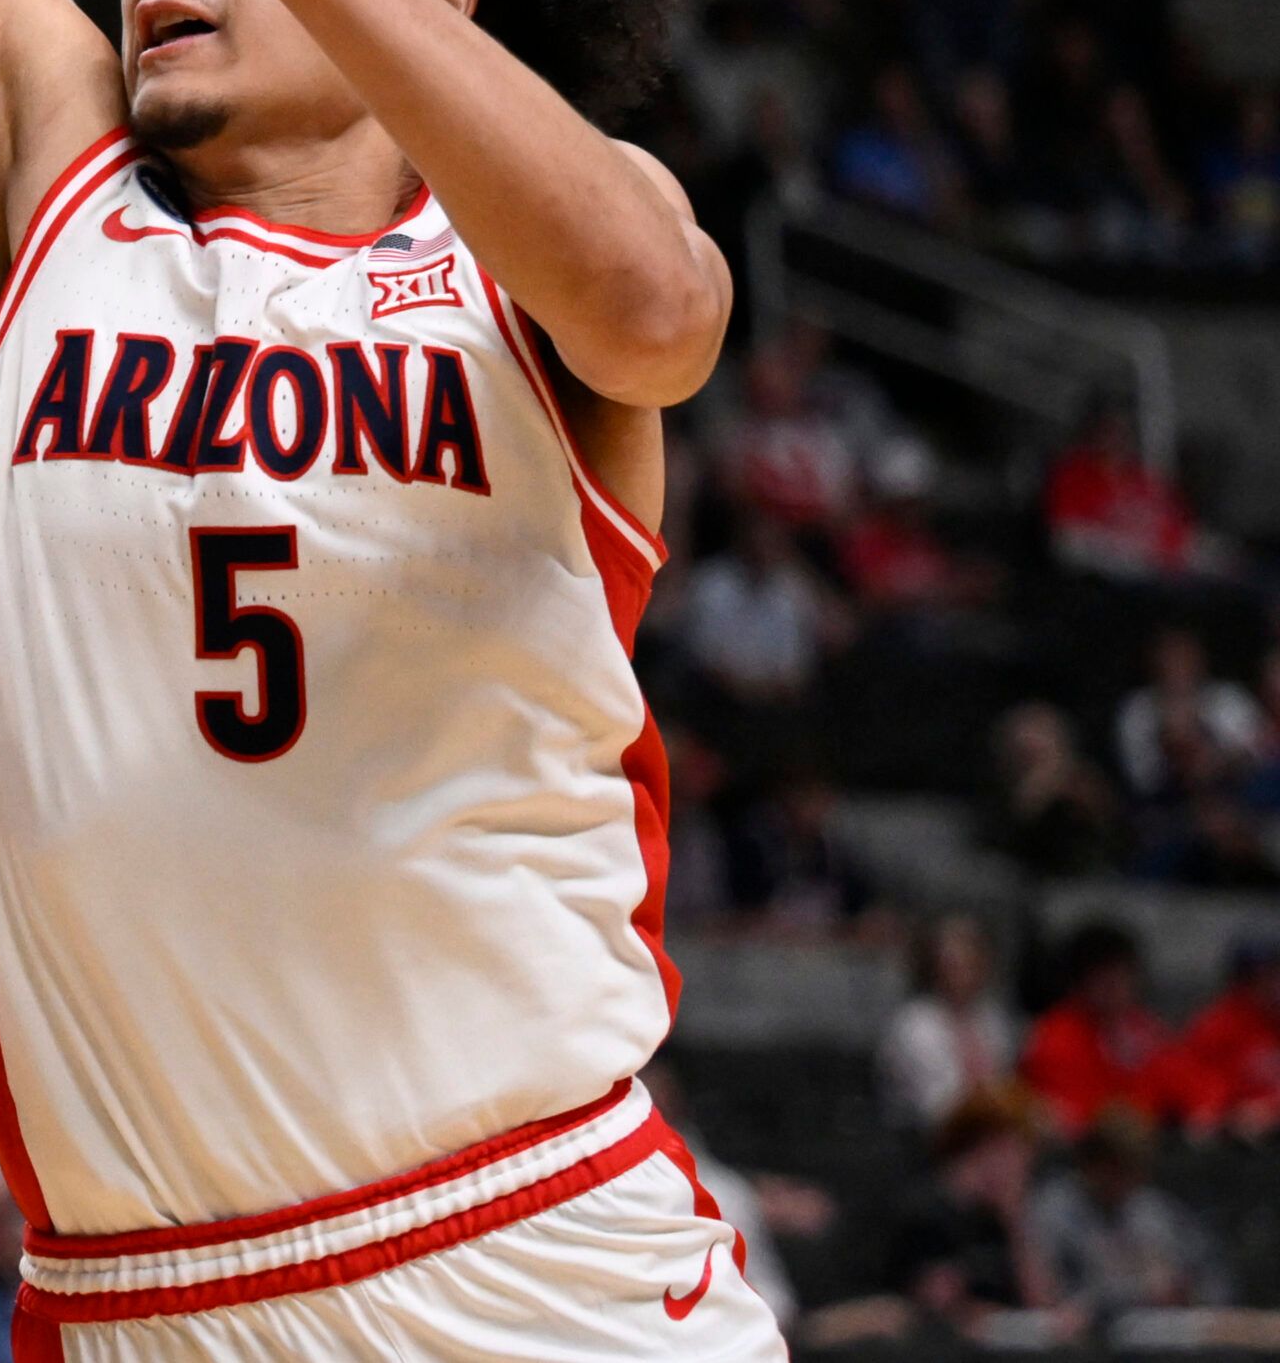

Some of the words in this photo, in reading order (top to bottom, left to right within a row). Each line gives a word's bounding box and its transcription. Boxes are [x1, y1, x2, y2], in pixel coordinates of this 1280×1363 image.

[367, 252, 464, 320] XII
[12, 329, 491, 496] ARIZONA
[189, 525, 307, 763] 5
